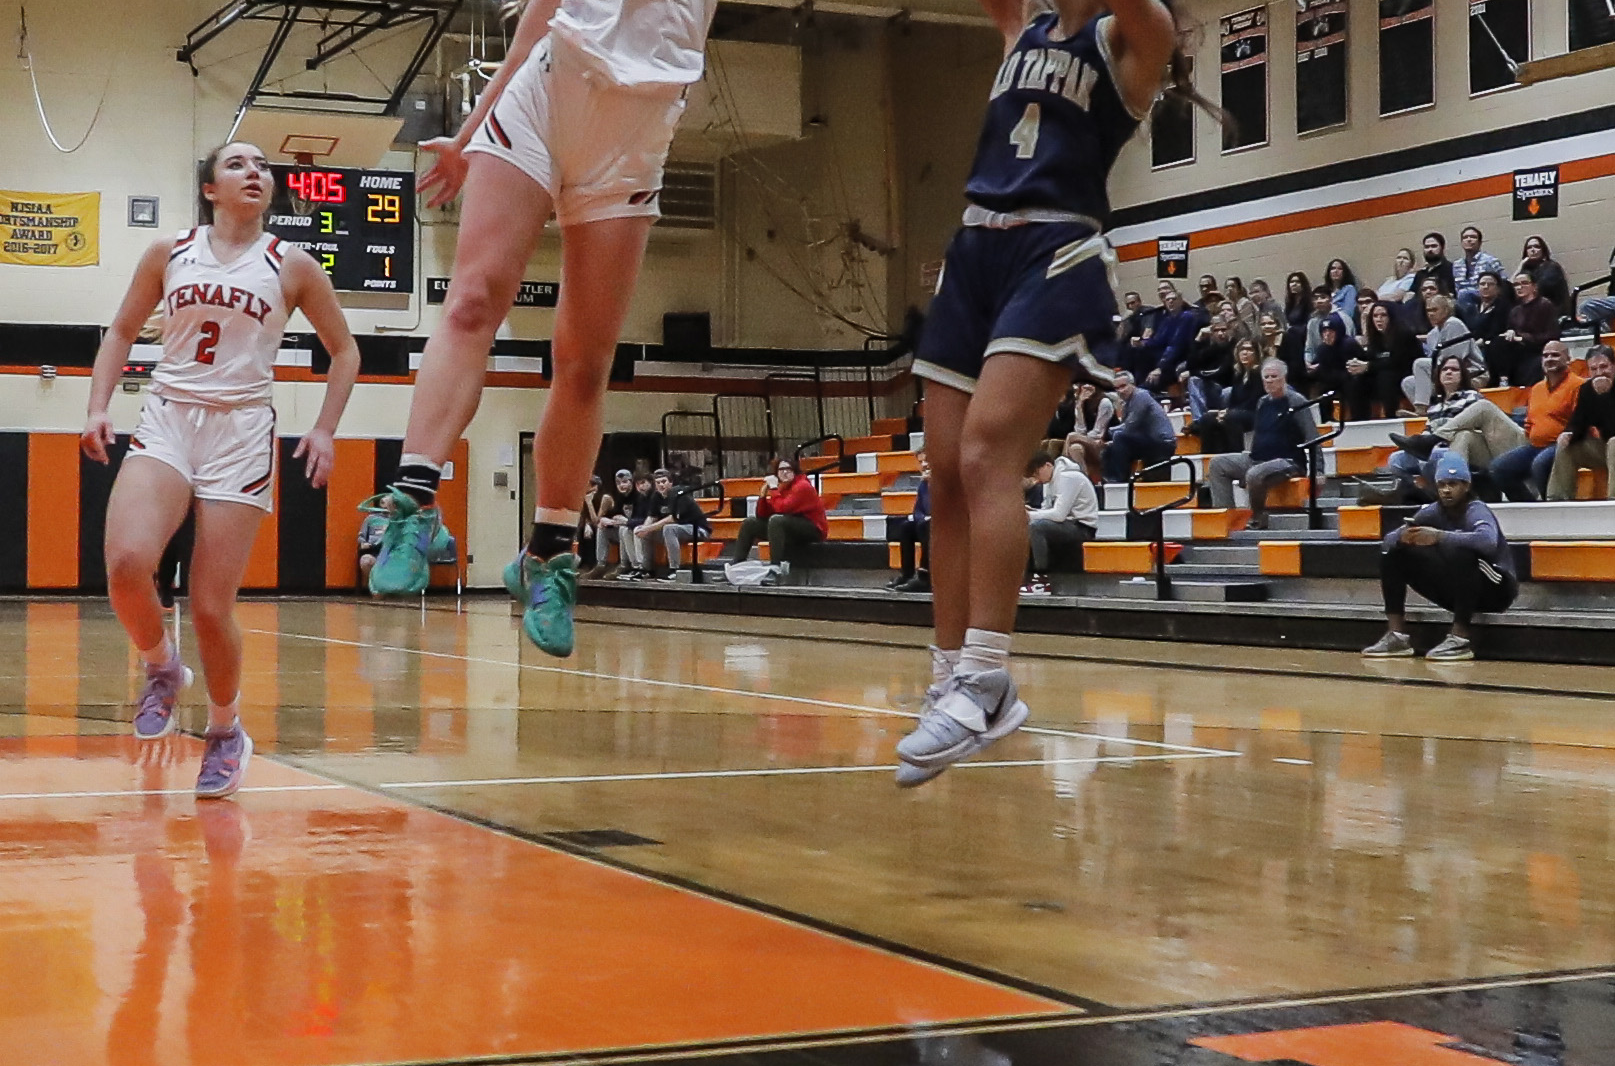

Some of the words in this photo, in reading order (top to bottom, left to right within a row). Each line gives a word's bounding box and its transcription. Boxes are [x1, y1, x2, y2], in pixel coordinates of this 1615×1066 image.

[1009, 102, 1041, 159] 4
[287, 172, 346, 203] 4:05
[360, 175, 403, 190] HOME
[1514, 170, 1557, 188] TENAFLY
[367, 194, 401, 223] 29
[268, 214, 313, 227] PERIOD
[320, 211, 333, 233] 3
[10, 228, 53, 241] AWARD
[366, 245, 396, 255] FOULS
[321, 253, 335, 275] 2
[383, 256, 391, 278] 1
[363, 279, 397, 289] POINTS
[167, 283, 273, 326] TENAFLY
[195, 320, 221, 365] 2
